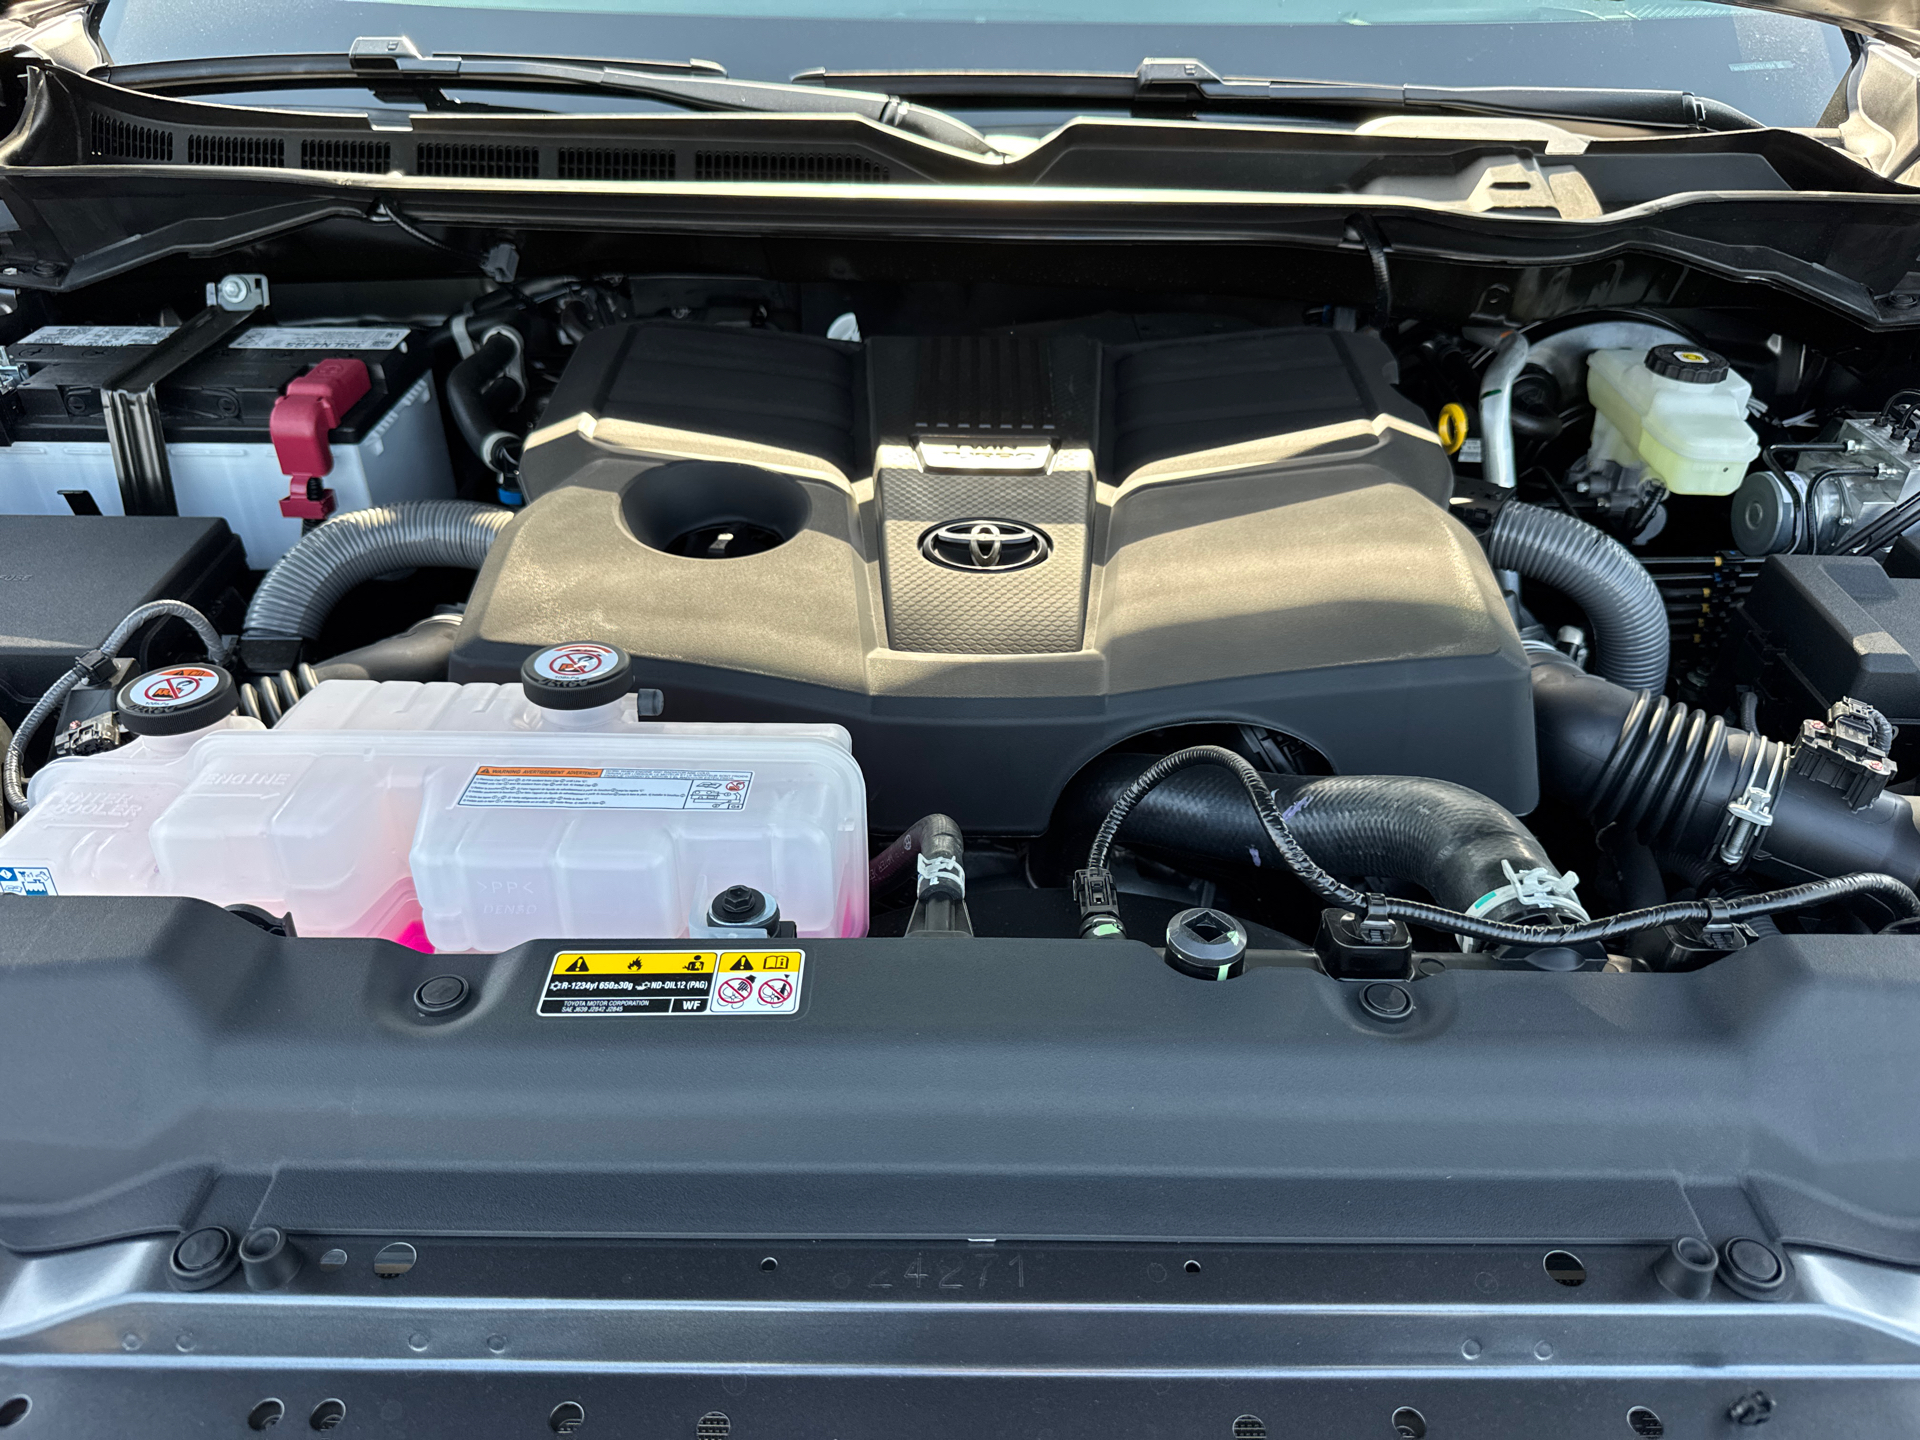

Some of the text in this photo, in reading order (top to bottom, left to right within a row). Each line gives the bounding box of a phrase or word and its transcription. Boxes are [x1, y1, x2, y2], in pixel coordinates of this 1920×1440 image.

[203, 773, 291, 785] ENGINE
[62, 792, 133, 803] INTER
[52, 803, 142, 817] COOLER
[483, 903, 538, 915] DENSO
[561, 981, 598, 991] R-1234yf
[598, 981, 634, 991] 650±30g
[687, 980, 708, 990] (PAG)
[682, 1000, 701, 1010] WF
[868, 1251, 1024, 1289] 24271
